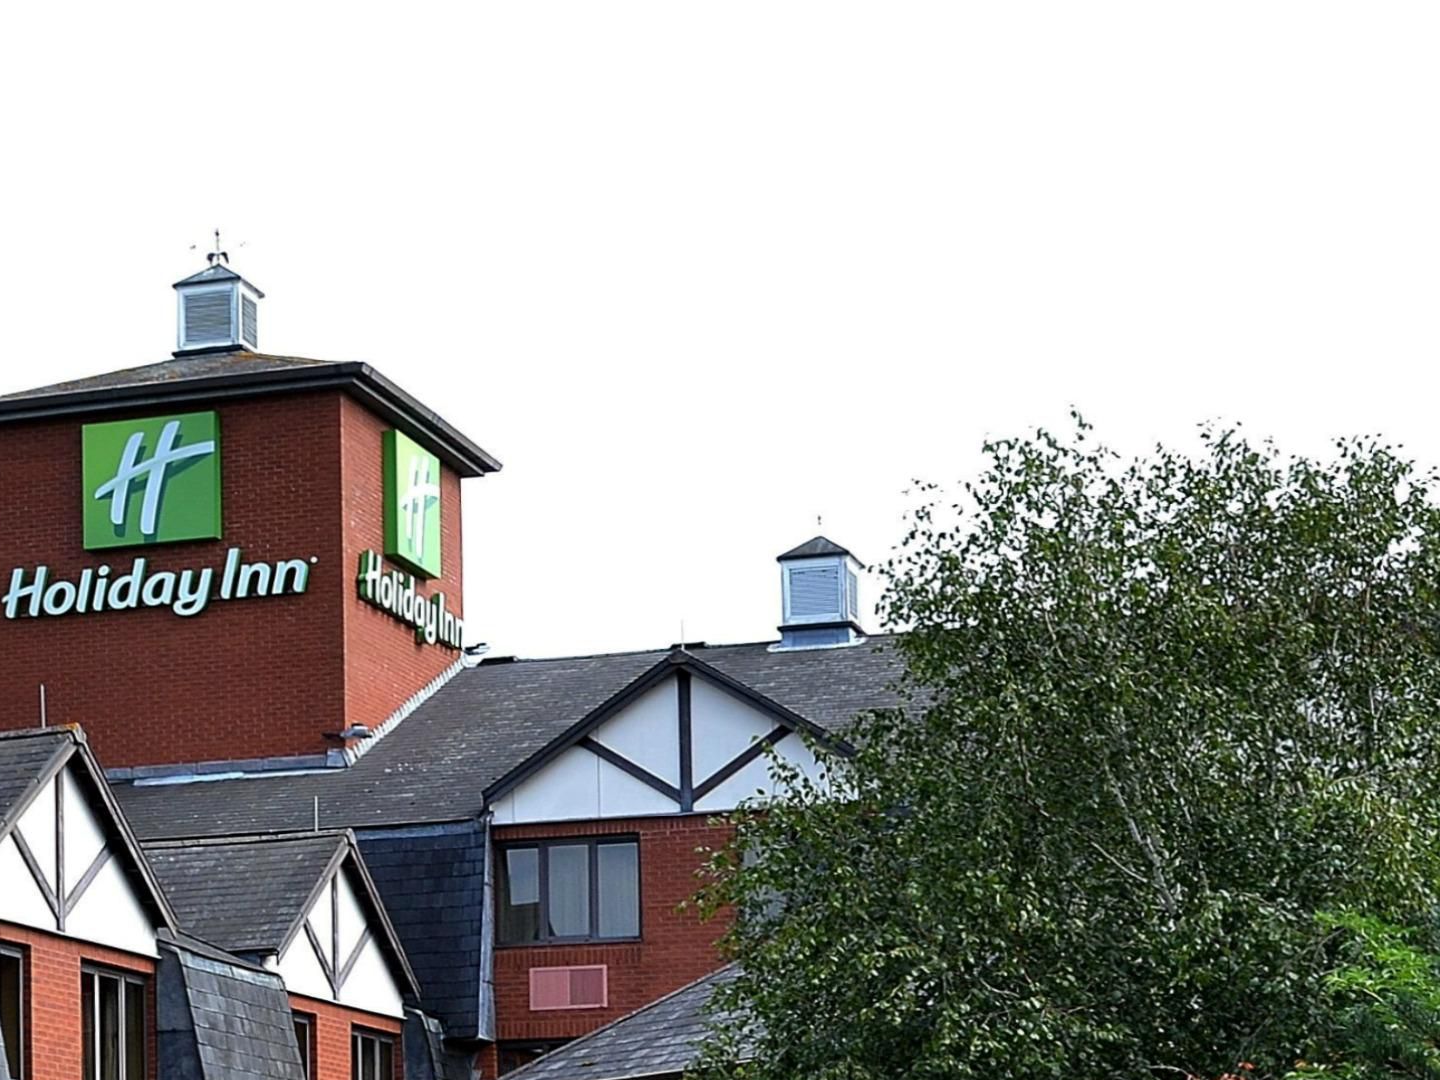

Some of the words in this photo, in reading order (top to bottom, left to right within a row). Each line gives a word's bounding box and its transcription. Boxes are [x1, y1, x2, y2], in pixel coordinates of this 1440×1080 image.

[94, 420, 215, 535] H
[1, 557, 213, 618] Holiday
[219, 547, 310, 600] Inn
[359, 549, 437, 645] Holiday
[438, 591, 464, 648] Inn
